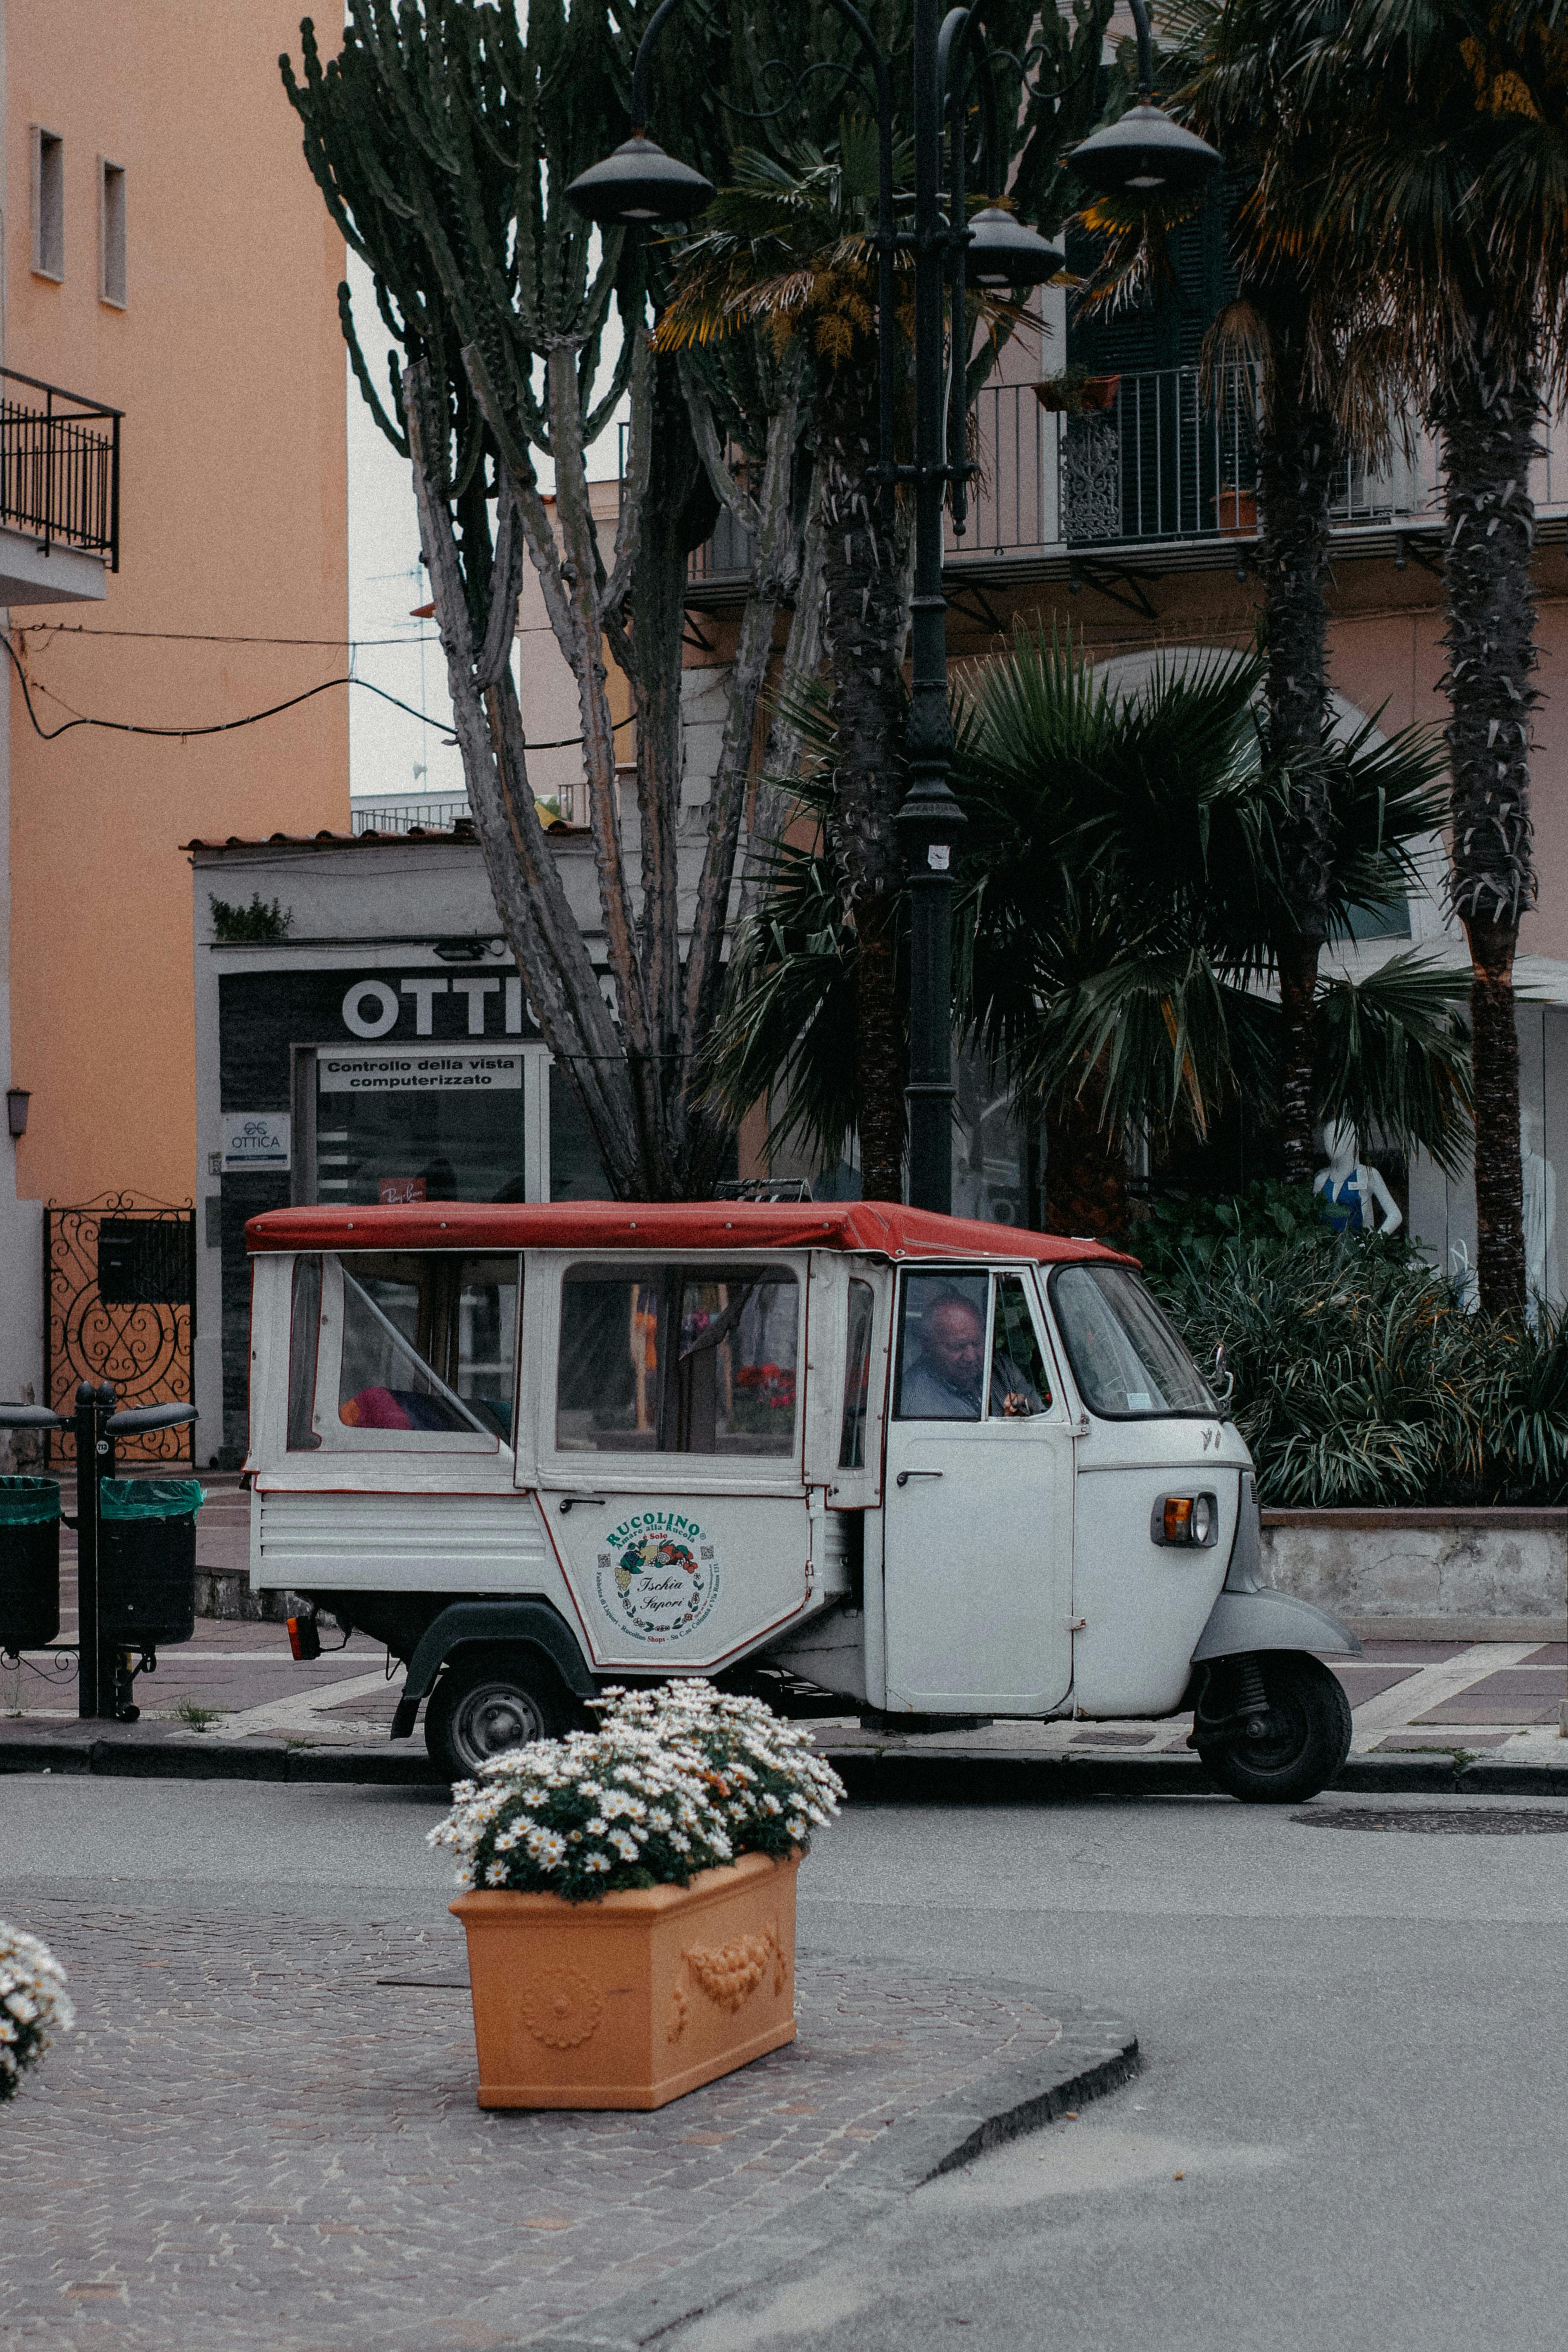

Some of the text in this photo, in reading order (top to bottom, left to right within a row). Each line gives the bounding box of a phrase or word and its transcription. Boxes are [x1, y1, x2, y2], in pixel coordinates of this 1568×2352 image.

[342, 975, 622, 1038] OTTI
[328, 1059, 514, 1073] Controllo della vista
[350, 1075, 492, 1088] computerizzato
[232, 1136, 280, 1148] OTTICA
[606, 1512, 700, 1547] RUCOLINO
[616, 1528, 643, 1550] Amaro
[666, 1525, 695, 1543] Rucola
[637, 1576, 683, 1592] Ischia
[640, 1596, 685, 1612] Sapori
[603, 1605, 618, 1625] Liquori
[621, 1625, 646, 1640] Rucolino
[692, 1608, 711, 1629] Colonna
